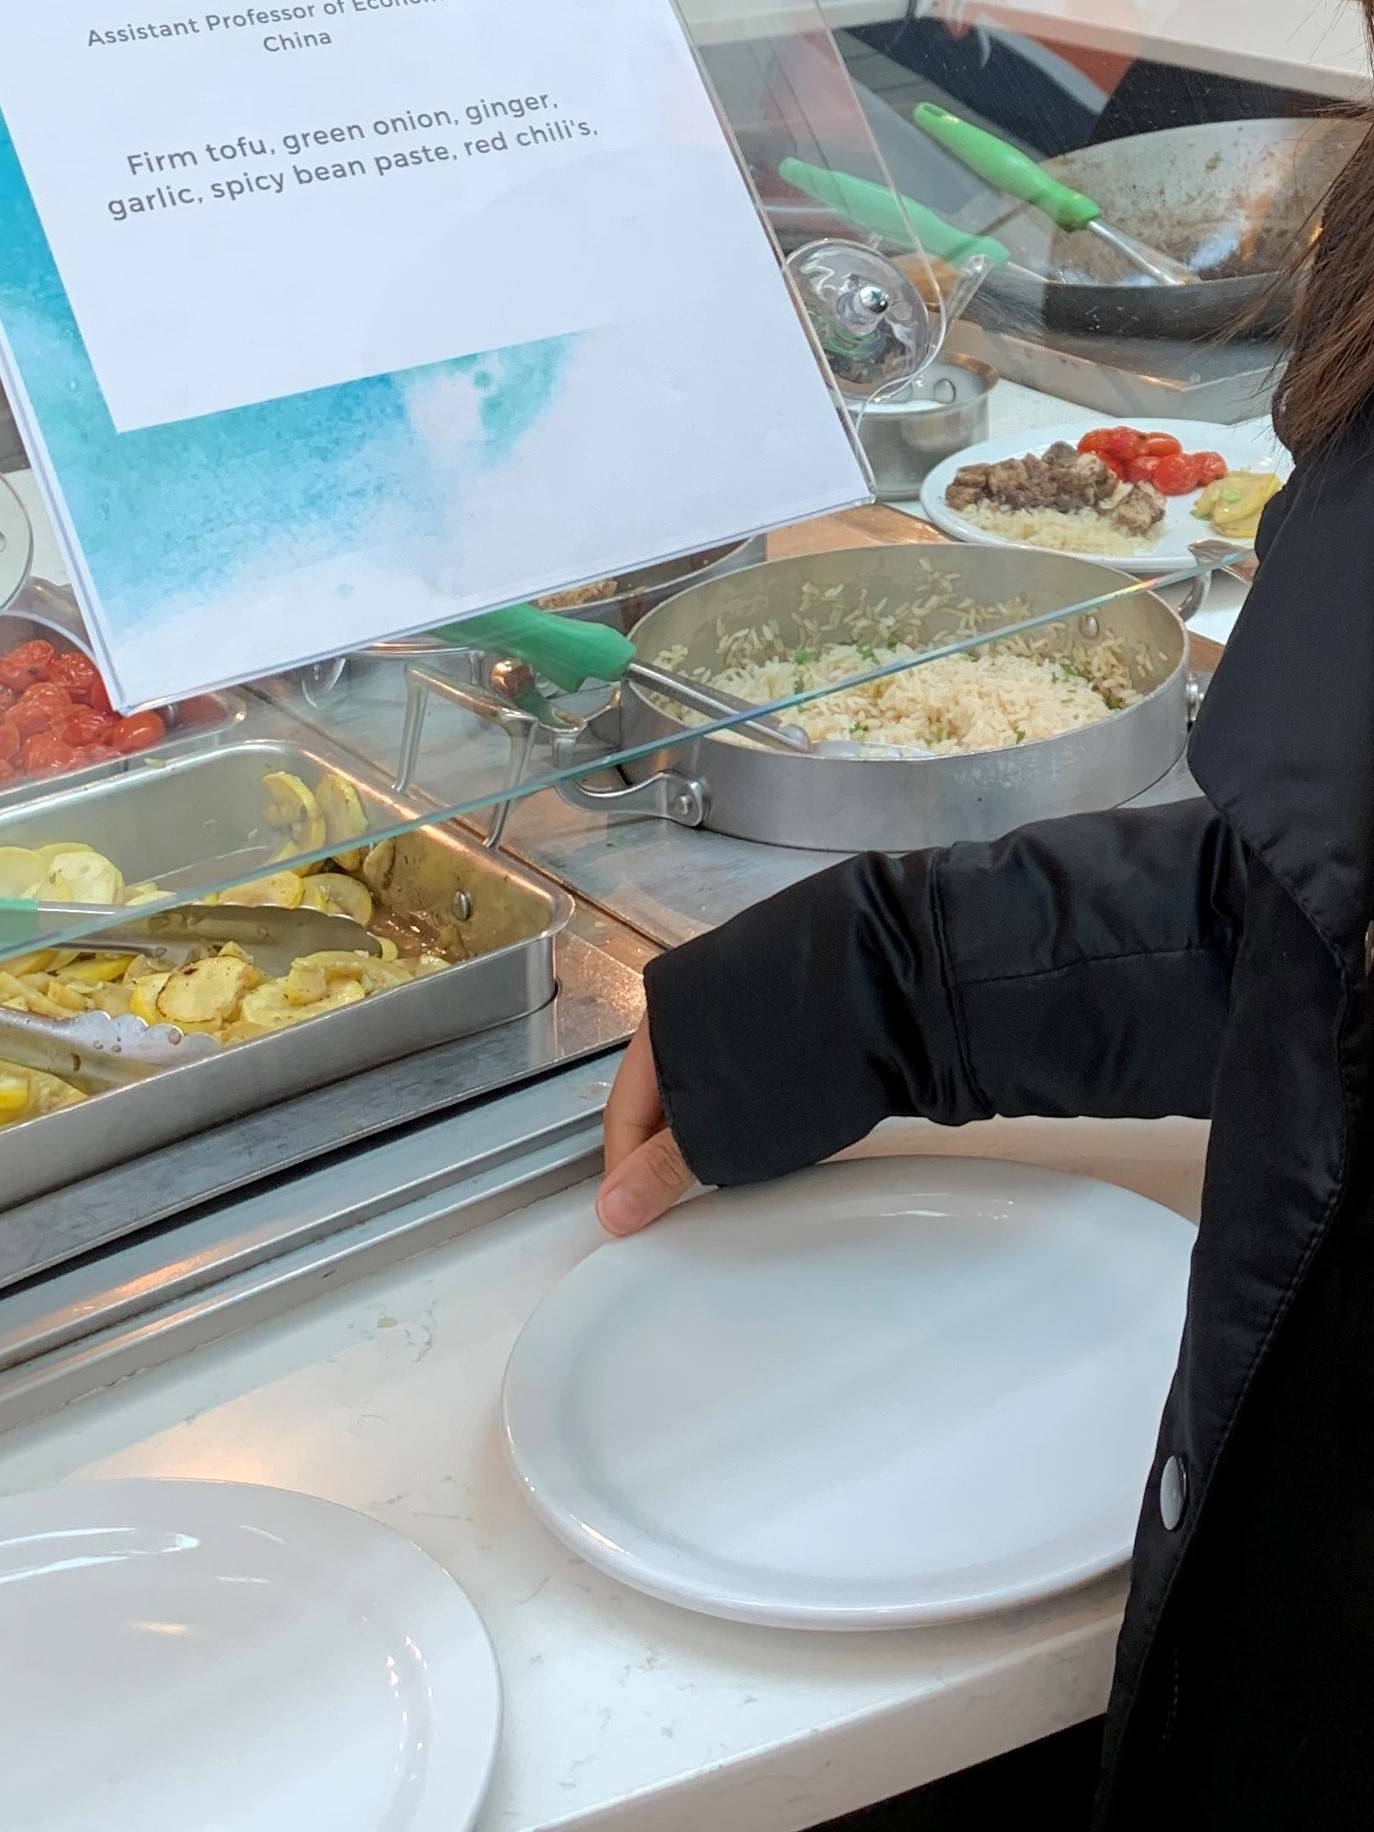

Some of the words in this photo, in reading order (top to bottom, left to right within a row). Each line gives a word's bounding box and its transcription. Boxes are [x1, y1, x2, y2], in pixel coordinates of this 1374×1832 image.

[87, 17, 200, 47] Assistant
[205, 5, 315, 31] Professor
[263, 31, 333, 53] China
[126, 151, 198, 176] Firm
[205, 136, 276, 163] tofu,
[282, 124, 366, 156] green
[372, 109, 459, 136] onion,
[465, 93, 558, 125] ginger,
[107, 185, 204, 221] garlic,
[210, 171, 284, 201] spicy
[292, 159, 367, 185] bean
[373, 145, 458, 176] paste,
[463, 130, 509, 157] red
